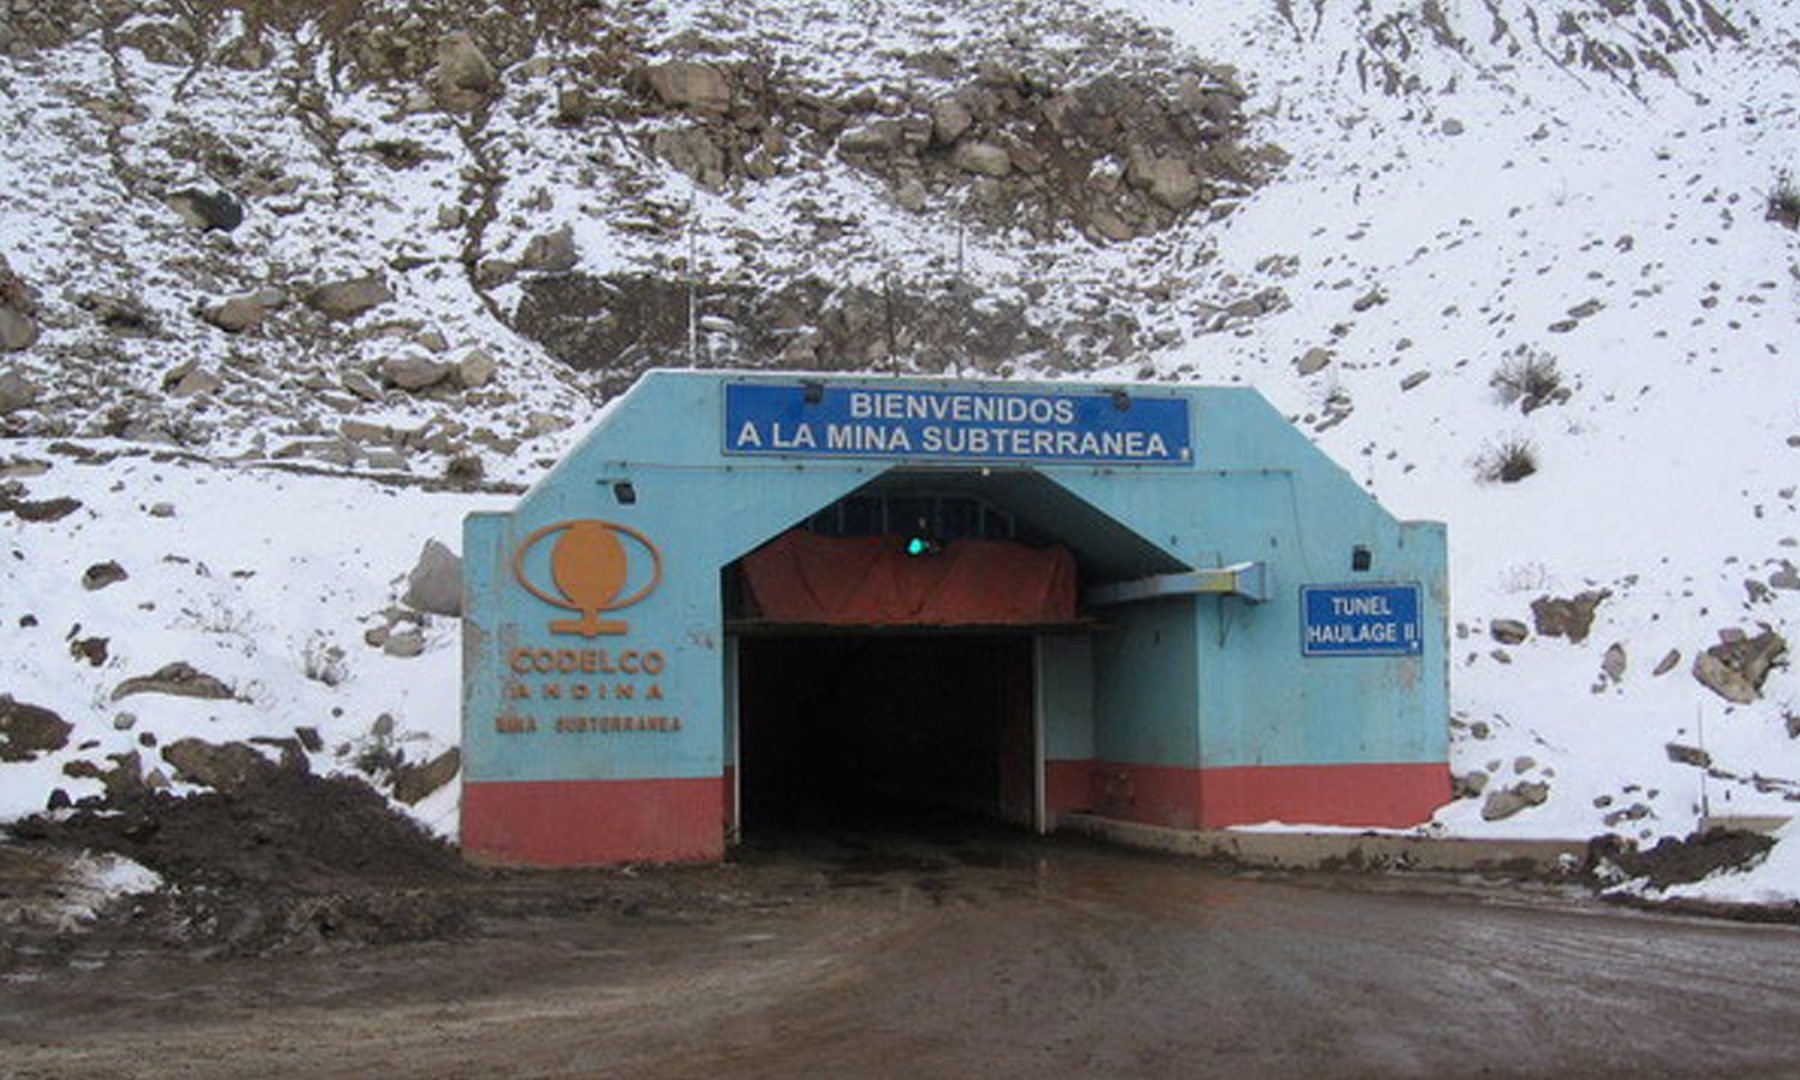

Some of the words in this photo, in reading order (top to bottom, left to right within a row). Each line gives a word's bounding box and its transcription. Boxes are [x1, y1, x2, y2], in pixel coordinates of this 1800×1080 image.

[850, 392, 1073, 424] BIENVENIDOS
[737, 421, 761, 447] A
[772, 423, 817, 448] LA
[827, 424, 910, 451] MINA
[922, 425, 1167, 457] SUBTERRANEA
[1332, 596, 1391, 615] TUNEL
[1307, 622, 1397, 642] HAULAGE
[509, 649, 665, 674] CODELCO
[509, 683, 662, 700] ANDINA
[495, 715, 537, 733] MINA
[555, 716, 682, 733] SUBTERRANEA
